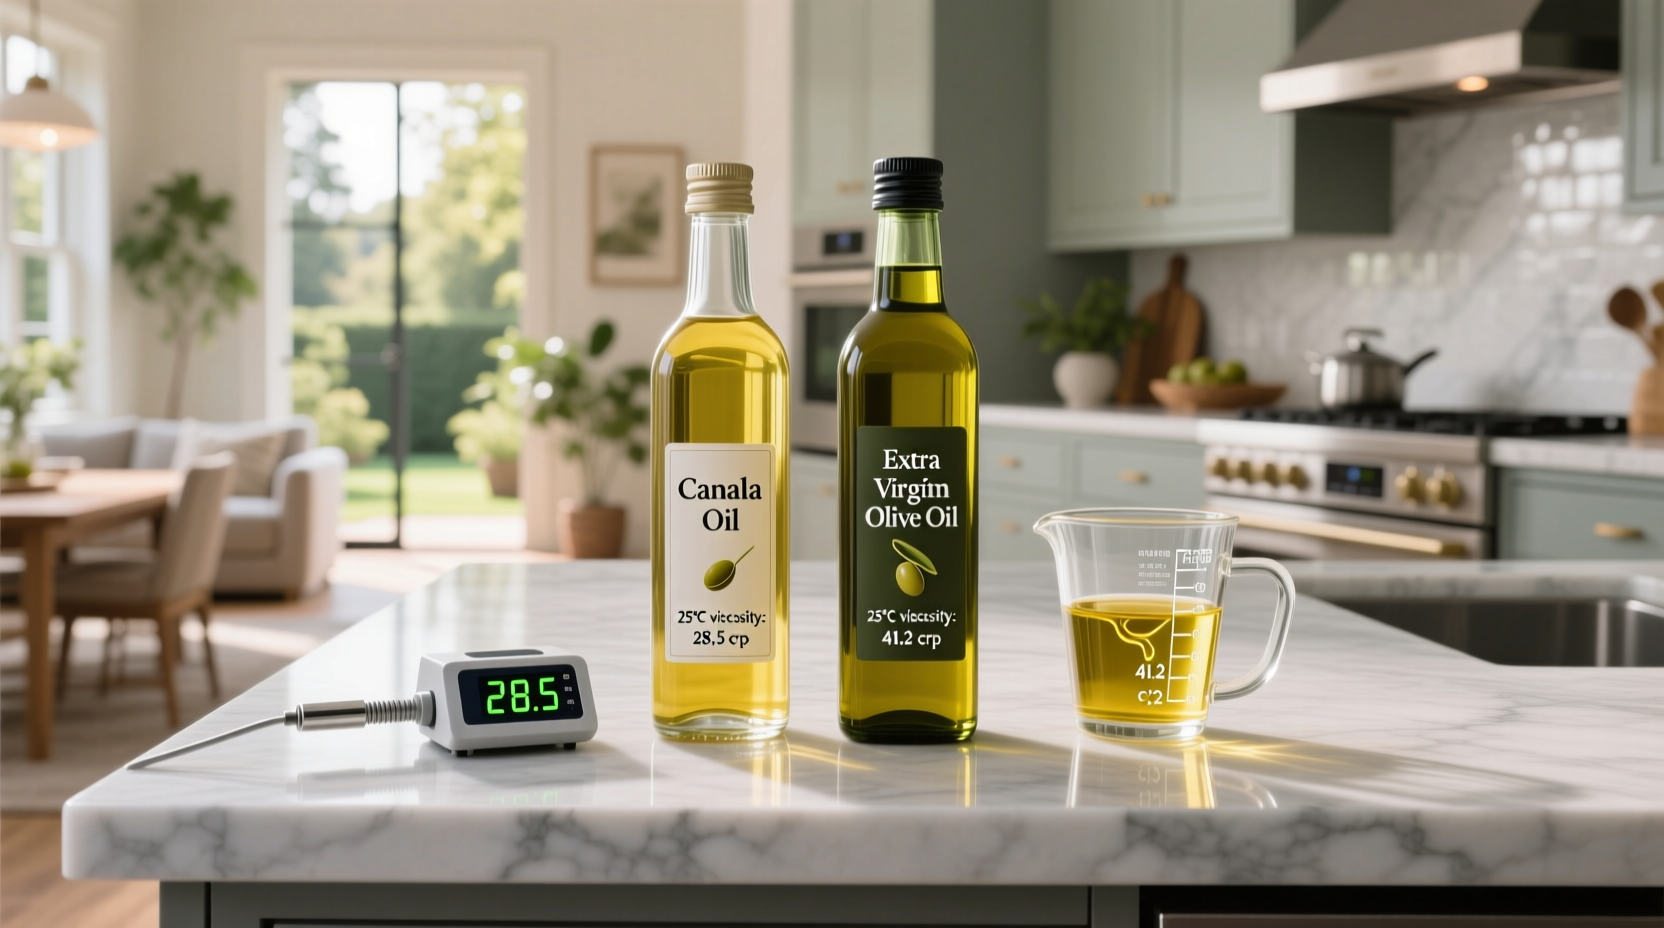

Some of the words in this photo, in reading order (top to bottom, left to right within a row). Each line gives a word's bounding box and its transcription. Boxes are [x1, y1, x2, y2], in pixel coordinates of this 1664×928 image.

[882, 449, 941, 470] Extra
[677, 477, 762, 500] Canala
[702, 509, 740, 531] Oil
[865, 506, 922, 528] Olive
[925, 505, 959, 528] Oil
[881, 630, 913, 646] 41.2
[1135, 663, 1165, 680] 41.2
[486, 676, 559, 715] 28.5
